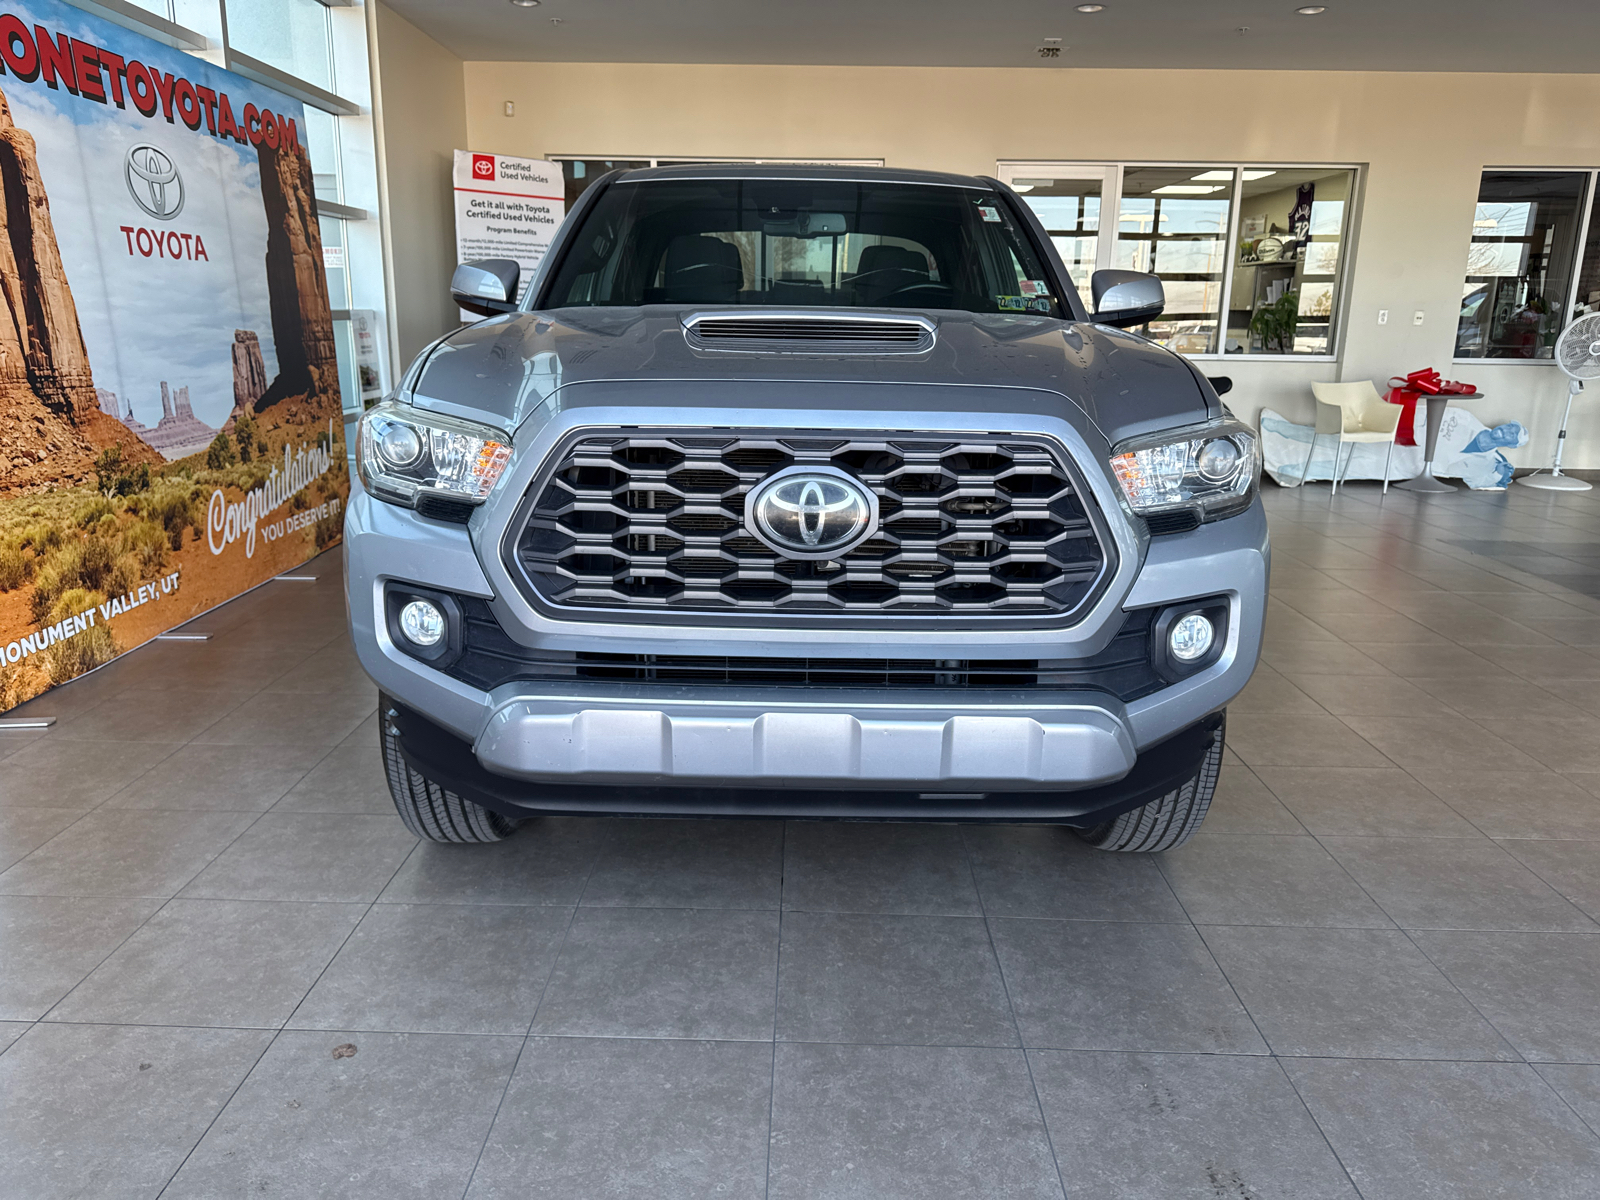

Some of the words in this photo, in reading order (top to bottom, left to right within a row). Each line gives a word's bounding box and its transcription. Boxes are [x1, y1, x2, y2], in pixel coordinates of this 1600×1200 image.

[0, 13, 299, 155] ONETOYOTA.COM
[500, 161, 531, 172] Certified
[500, 172, 519, 180] Used
[520, 174, 548, 184] Vehicles
[470, 199, 486, 209] Get
[487, 200, 494, 209] it
[494, 201, 506, 210] all
[506, 202, 524, 211] with
[525, 204, 550, 214] Toyota
[466, 210, 502, 220] Certified
[503, 212, 523, 222] Used
[523, 215, 555, 224] Vehicles
[486, 225, 513, 235] Program
[513, 227, 537, 236] Benefits
[1295, 221, 1310, 241] 32
[119, 225, 209, 262] TOYOTA
[207, 417, 335, 559] Congratulations!
[261, 522, 285, 544] YOU
[286, 505, 329, 534] DESERVE
[330, 498, 341, 517] IT!
[99, 581, 161, 621] VALLEY,
[160, 572, 180, 597] UT
